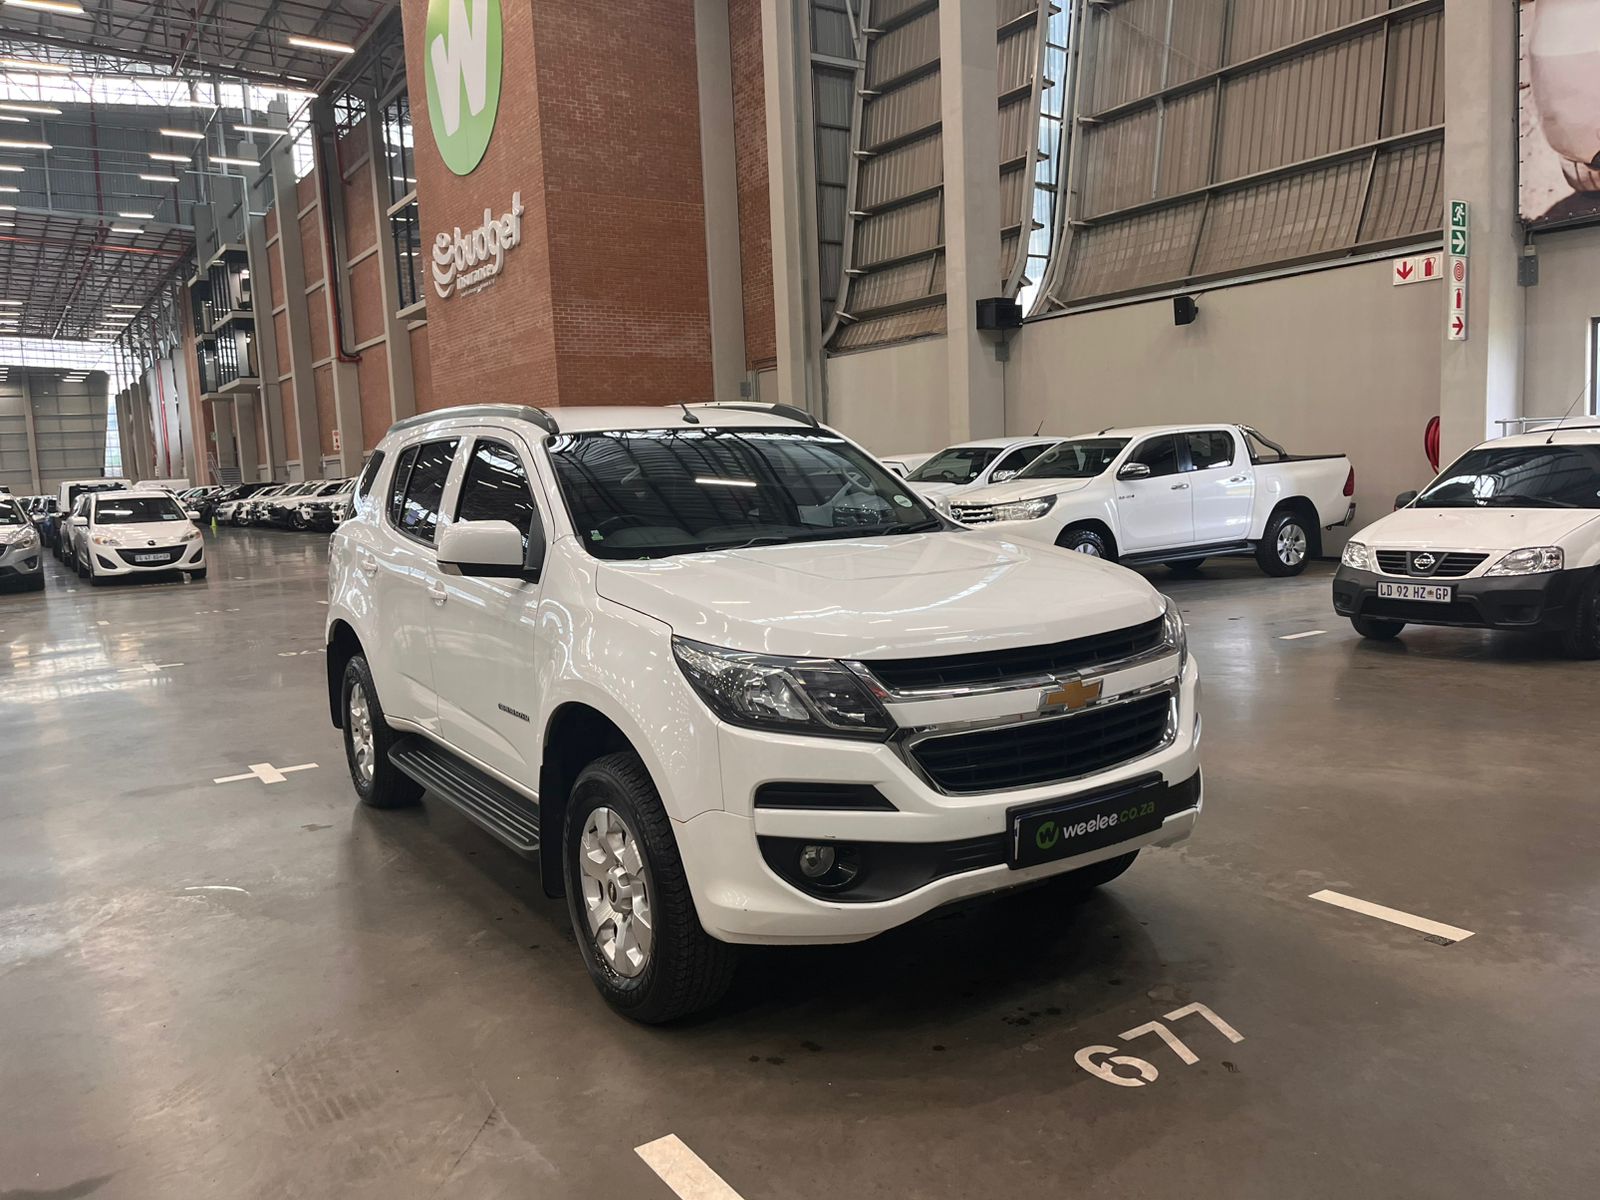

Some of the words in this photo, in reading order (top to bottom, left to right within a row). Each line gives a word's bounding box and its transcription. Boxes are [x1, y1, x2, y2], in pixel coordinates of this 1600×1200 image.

[454, 191, 524, 274] budget
[1380, 584, 1392, 596] LD
[1397, 586, 1409, 597] 92
[1413, 587, 1426, 599] HZ
[1435, 588, 1448, 600] GP
[1063, 801, 1155, 839] weelee.co.za
[1074, 1001, 1245, 1087] 677
